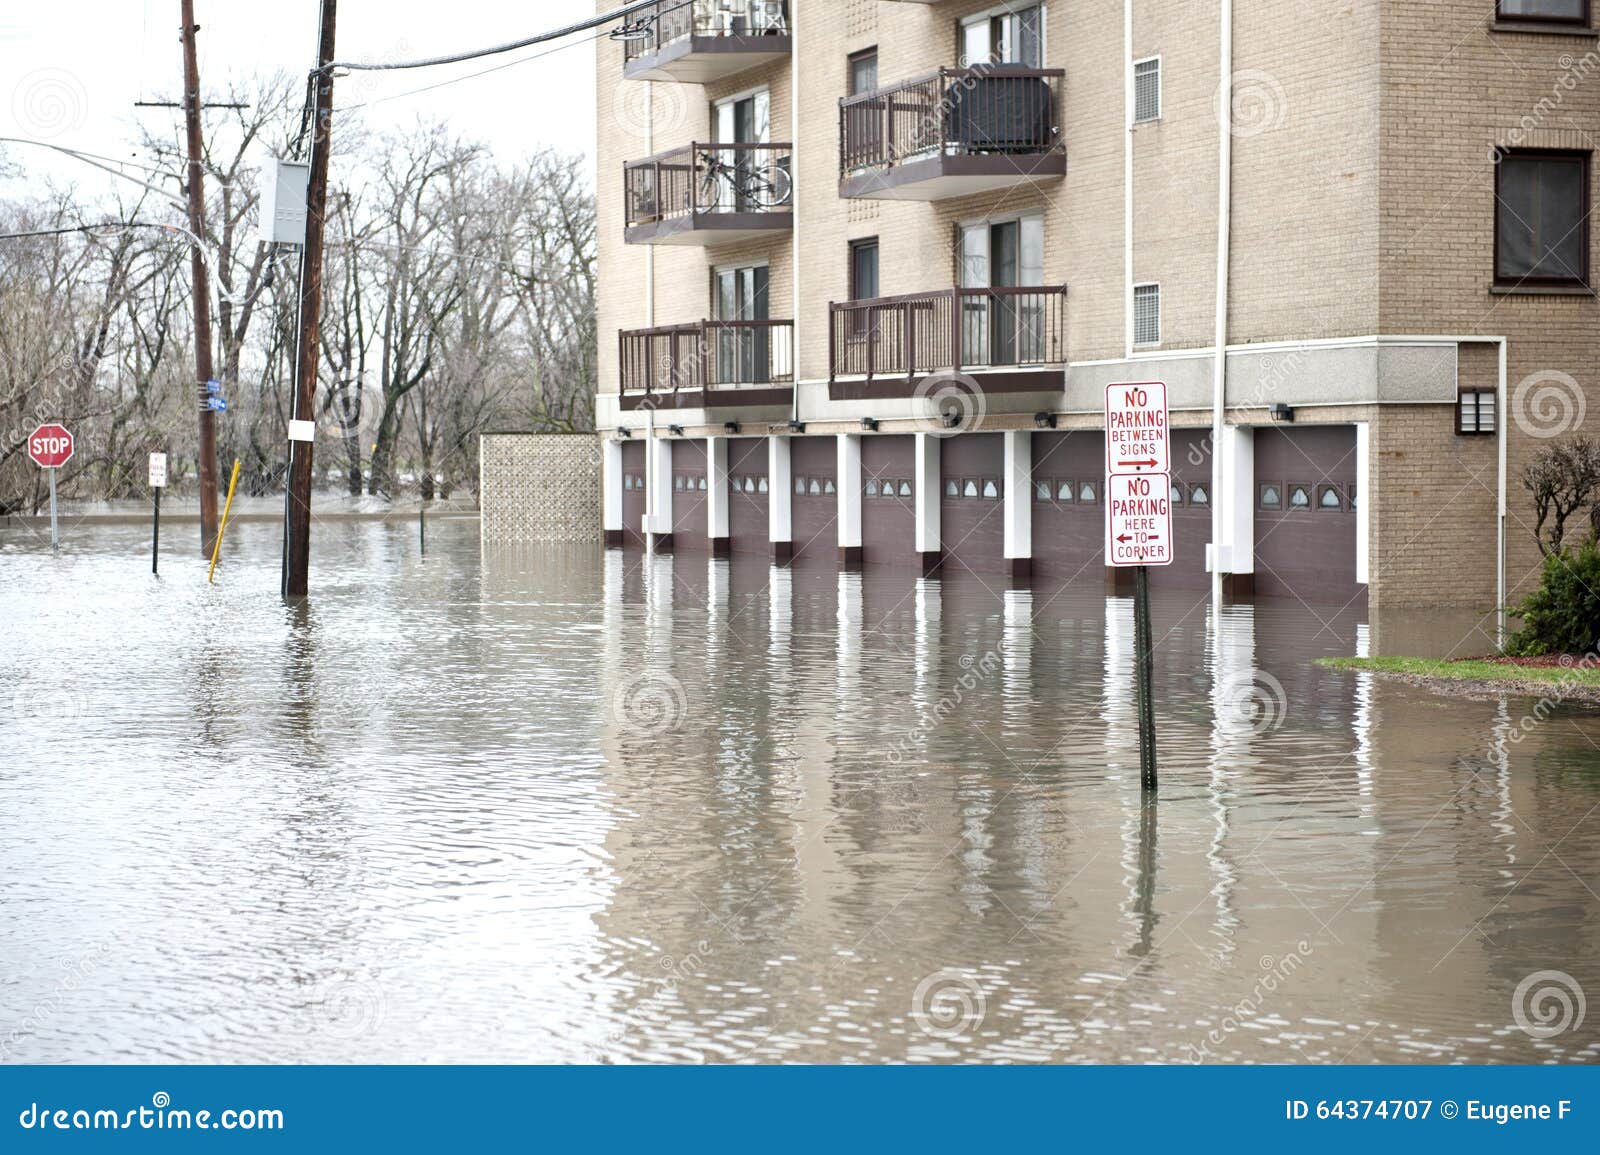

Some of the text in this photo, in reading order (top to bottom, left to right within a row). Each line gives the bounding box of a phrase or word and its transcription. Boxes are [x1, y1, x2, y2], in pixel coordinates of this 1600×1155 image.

[1125, 390, 1147, 407] NO
[1110, 410, 1163, 428] PARKING
[1112, 429, 1163, 442] BETWEEN
[33, 437, 69, 454] STOP
[1120, 443, 1156, 456] SIGNS
[1128, 479, 1150, 496] NO
[1113, 498, 1166, 516] PARKING
[1125, 518, 1155, 530] HERE
[1134, 532, 1147, 543] TO
[1118, 545, 1164, 558] CORNER
